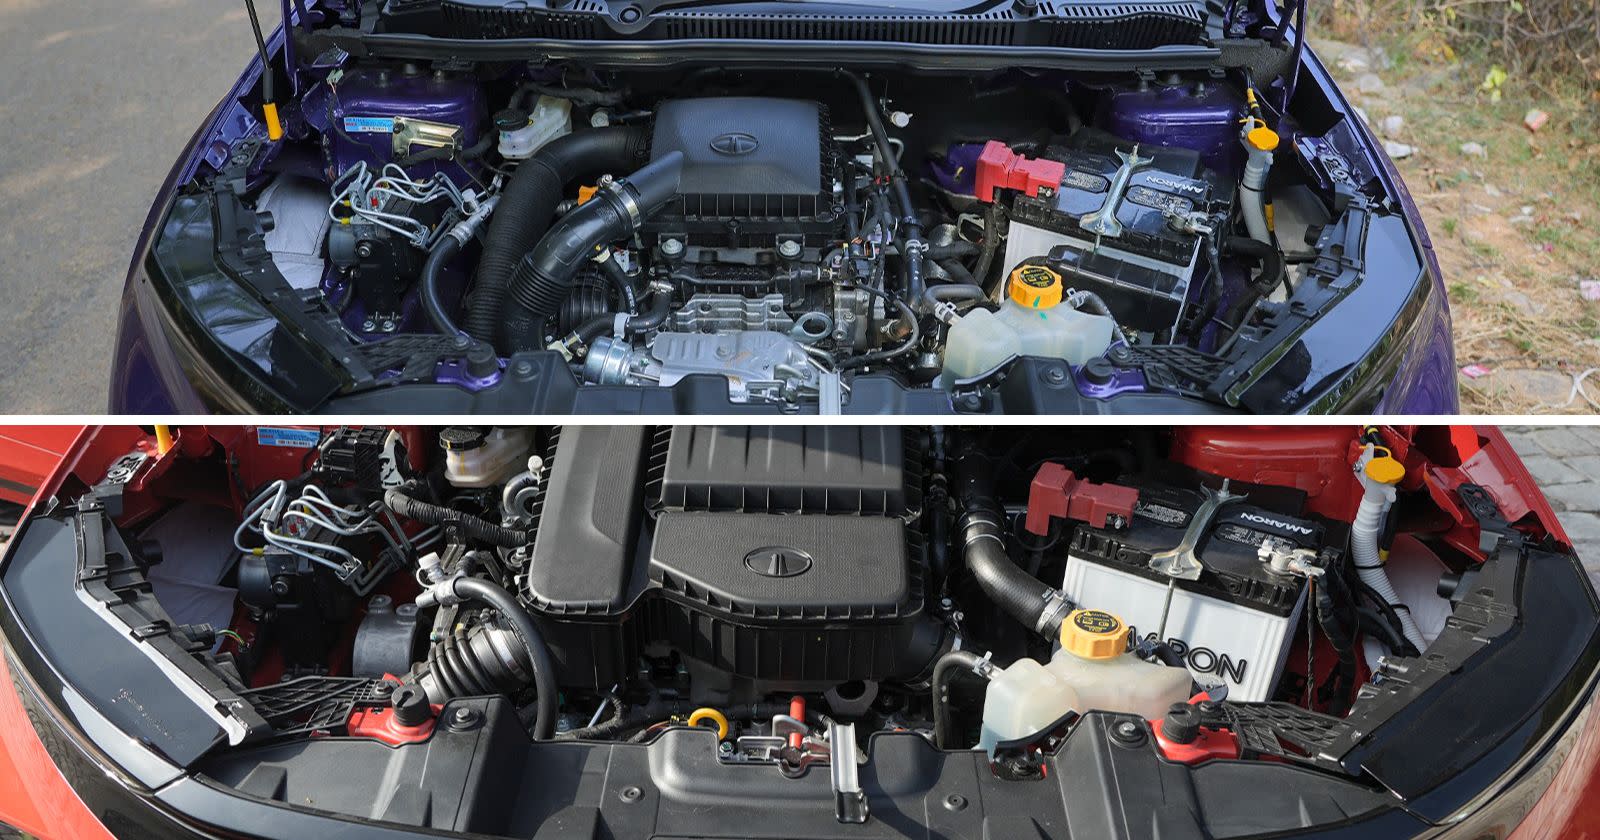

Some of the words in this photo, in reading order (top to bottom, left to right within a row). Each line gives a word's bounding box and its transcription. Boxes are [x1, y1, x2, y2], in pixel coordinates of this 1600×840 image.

[1146, 176, 1204, 194] AMARON
[1240, 512, 1313, 535] AMARON
[1126, 625, 1248, 685] RON
